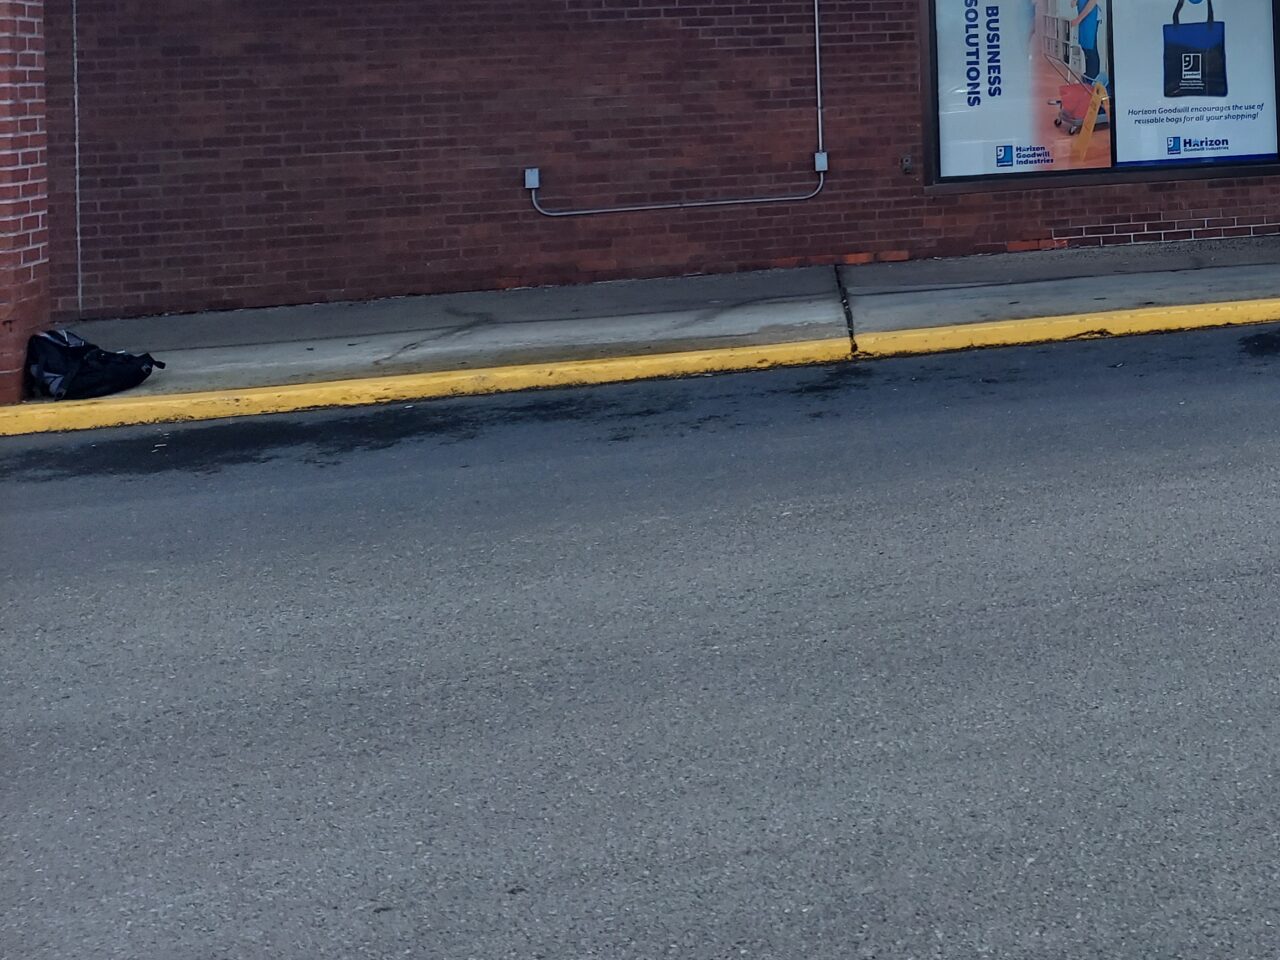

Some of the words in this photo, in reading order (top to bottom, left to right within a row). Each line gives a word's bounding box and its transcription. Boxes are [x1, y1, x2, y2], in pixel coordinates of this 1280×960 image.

[986, 6, 1002, 97] BUSINESS
[1257, 103, 1264, 112] of
[1166, 116, 1182, 124] bags
[1183, 116, 1194, 124] for
[1224, 112, 1259, 120] shopping!
[1184, 137, 1229, 147] Horizon
